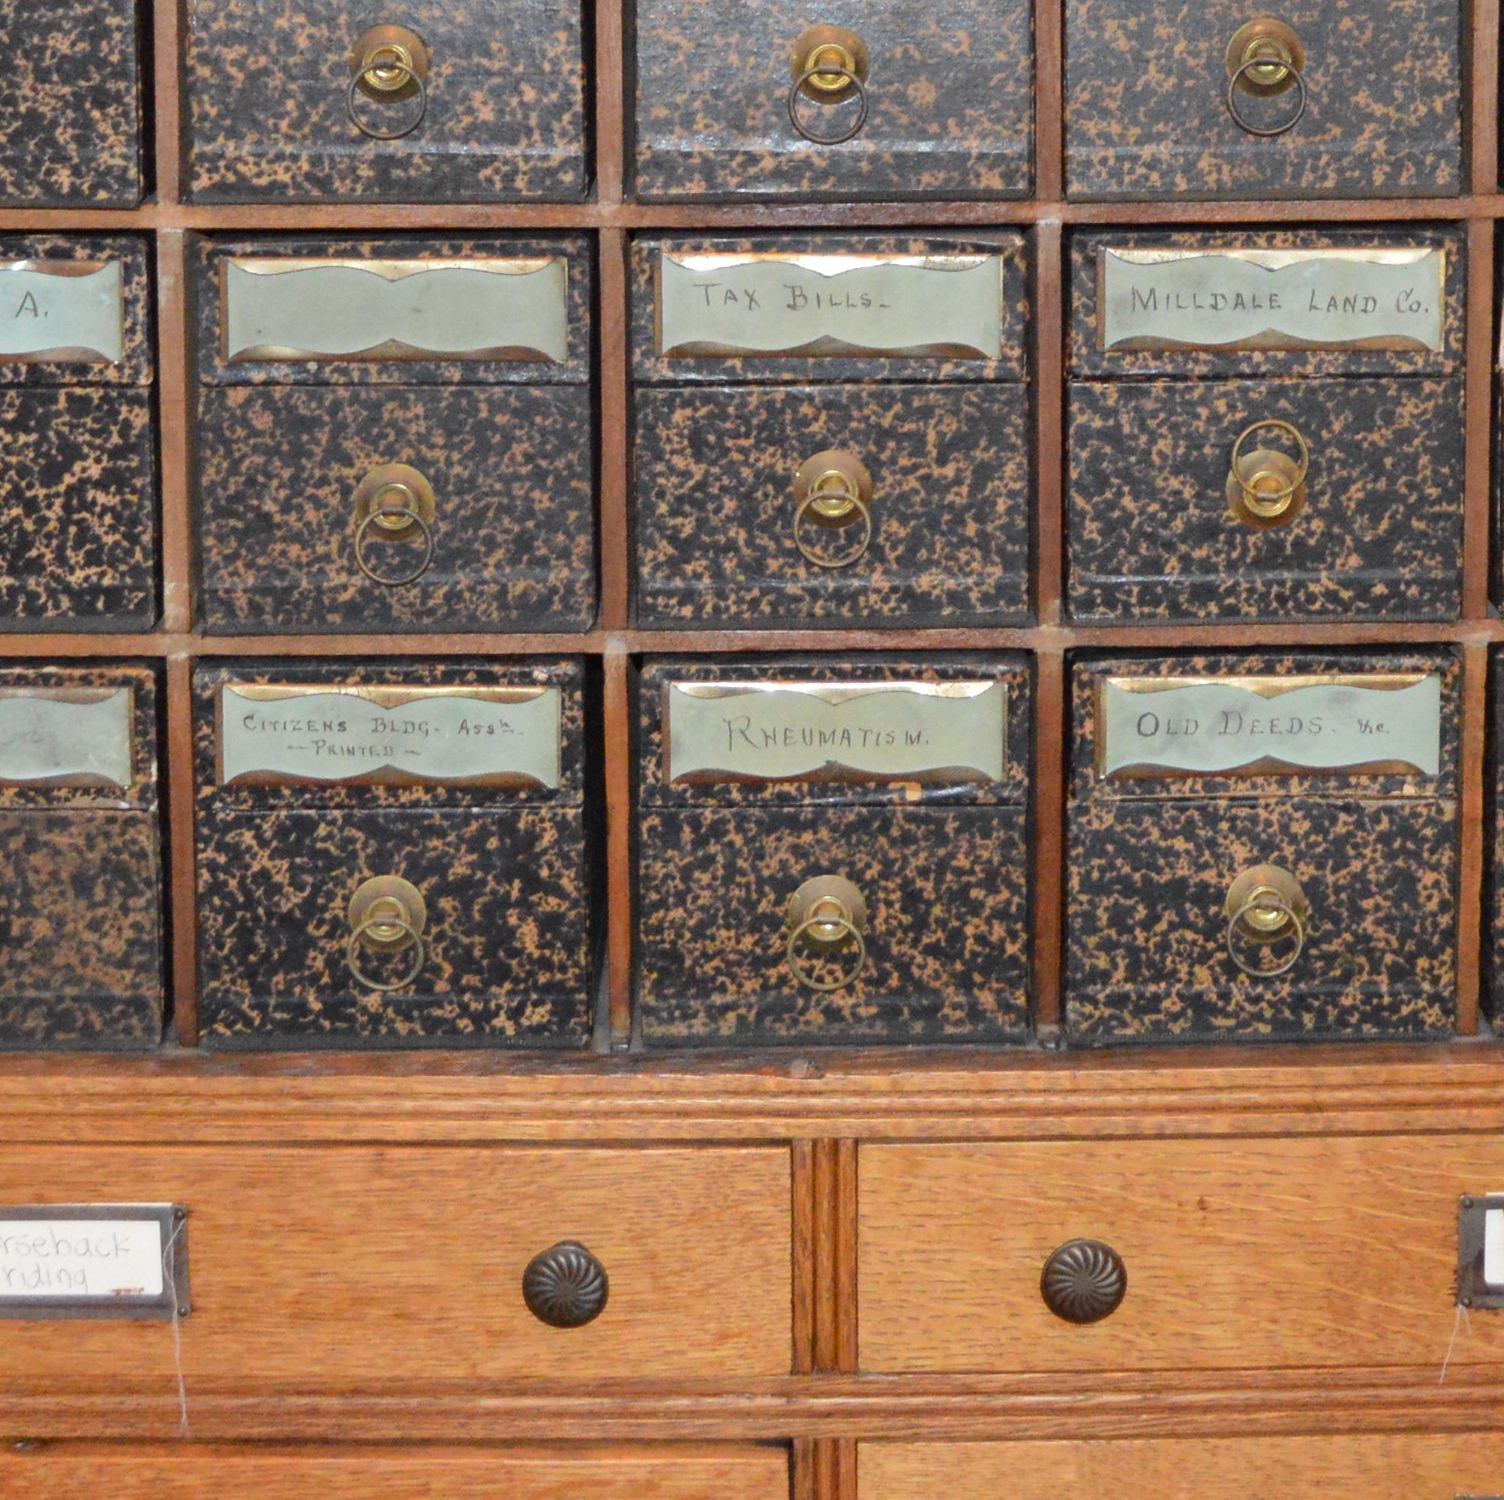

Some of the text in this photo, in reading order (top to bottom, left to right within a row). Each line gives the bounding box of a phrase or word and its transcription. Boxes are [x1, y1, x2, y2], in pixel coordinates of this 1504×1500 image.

[691, 282, 762, 310] TAX
[1130, 285, 1282, 313] MILLDALE
[1308, 286, 1378, 314] LAND
[241, 713, 349, 734] CITIZENS
[721, 714, 930, 753] RHEUMATISM.
[1136, 710, 1200, 739] OLD
[2, 1262, 89, 1293] riding
